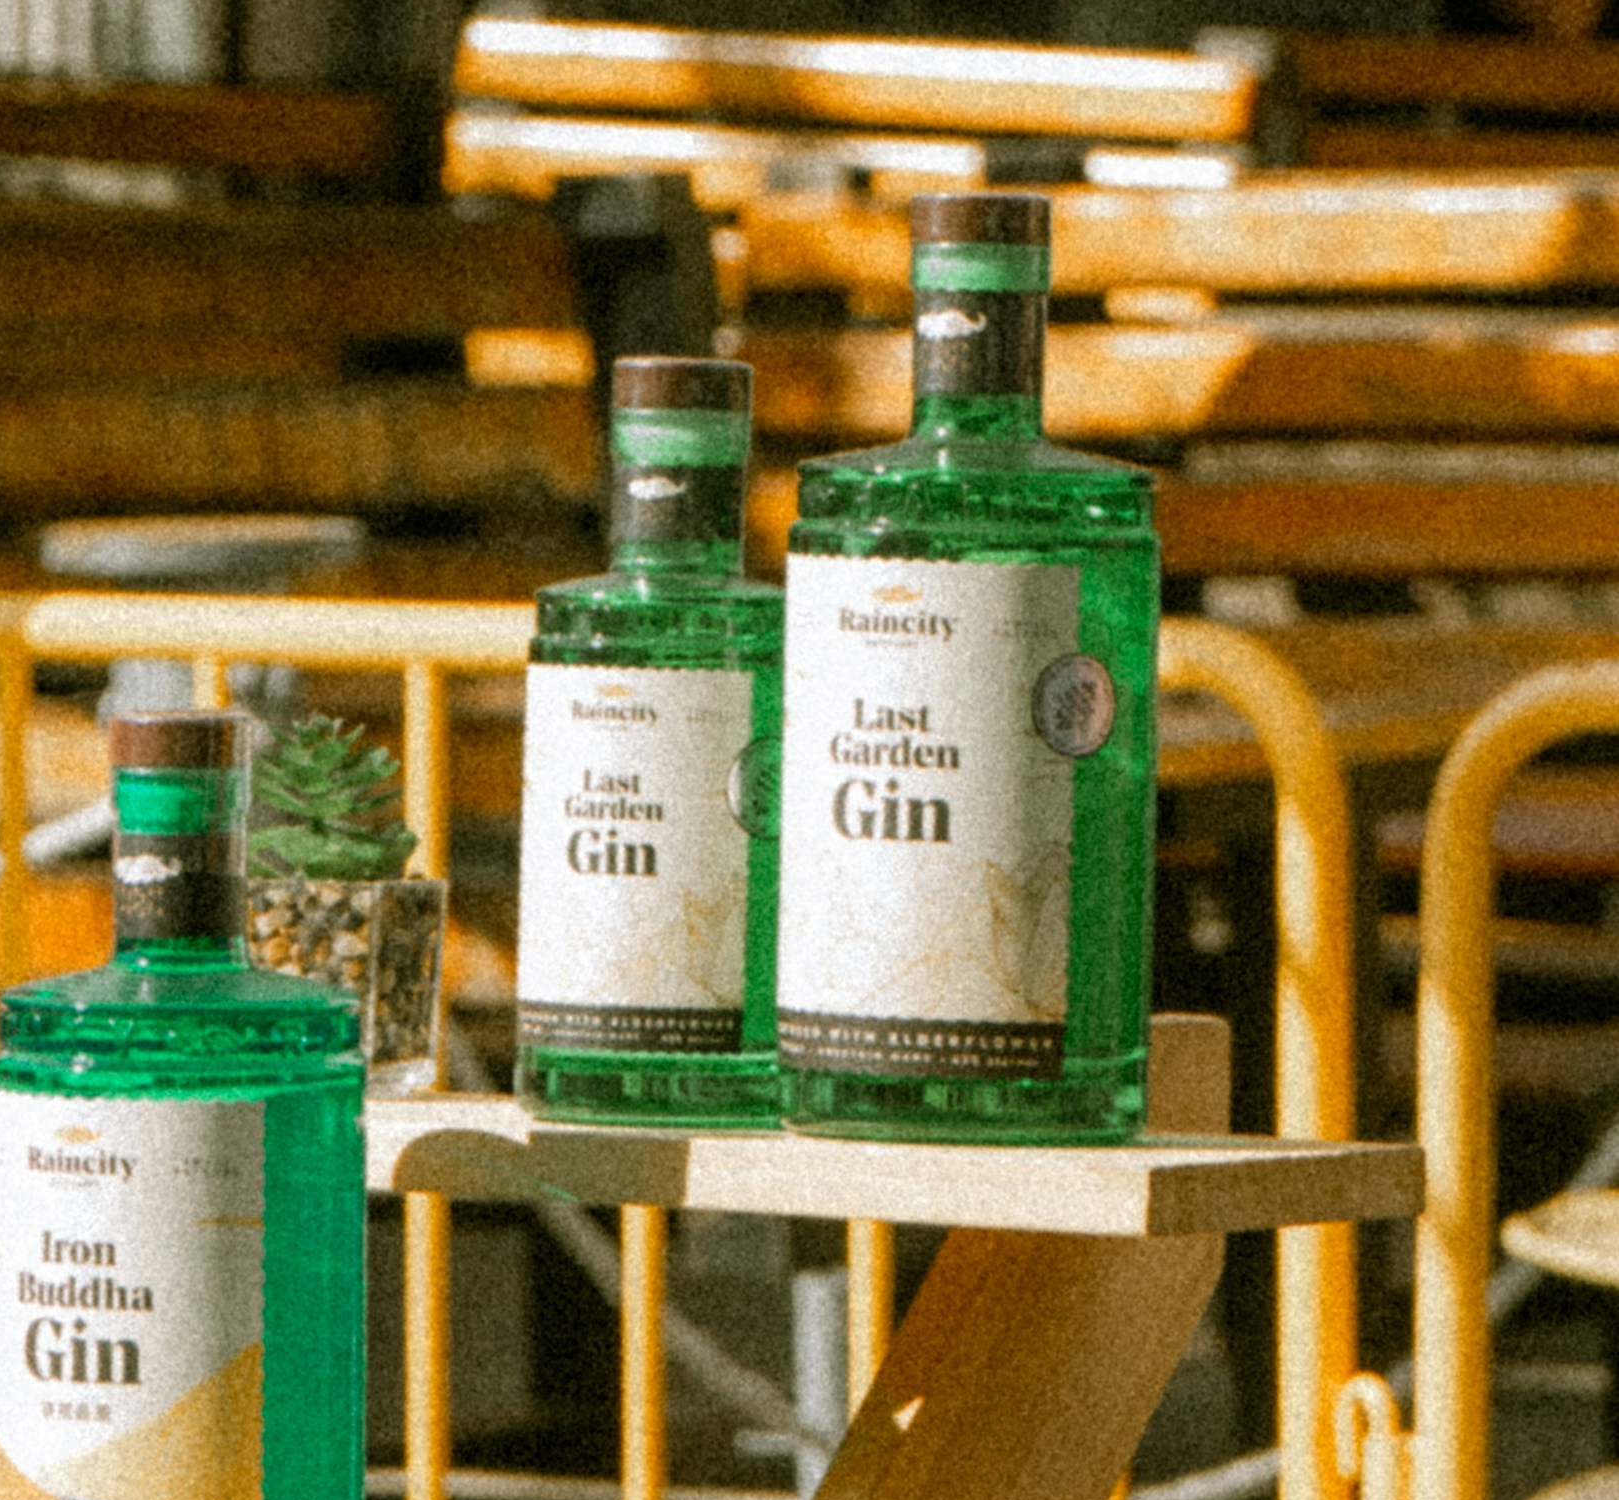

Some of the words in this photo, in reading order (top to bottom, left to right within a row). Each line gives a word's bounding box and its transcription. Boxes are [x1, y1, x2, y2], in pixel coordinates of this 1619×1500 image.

[838, 606, 960, 643] Raincity
[571, 700, 660, 727] Raincity
[852, 696, 932, 734] Last
[829, 732, 961, 771] Garden
[583, 768, 641, 796] Last
[563, 796, 664, 823] Garden
[831, 777, 953, 845] Gin
[566, 828, 659, 878] Gin
[26, 1144, 138, 1184] Raincity
[40, 1229, 118, 1269] Iron
[17, 1270, 155, 1314] Buddha
[22, 1316, 144, 1388] Gin
